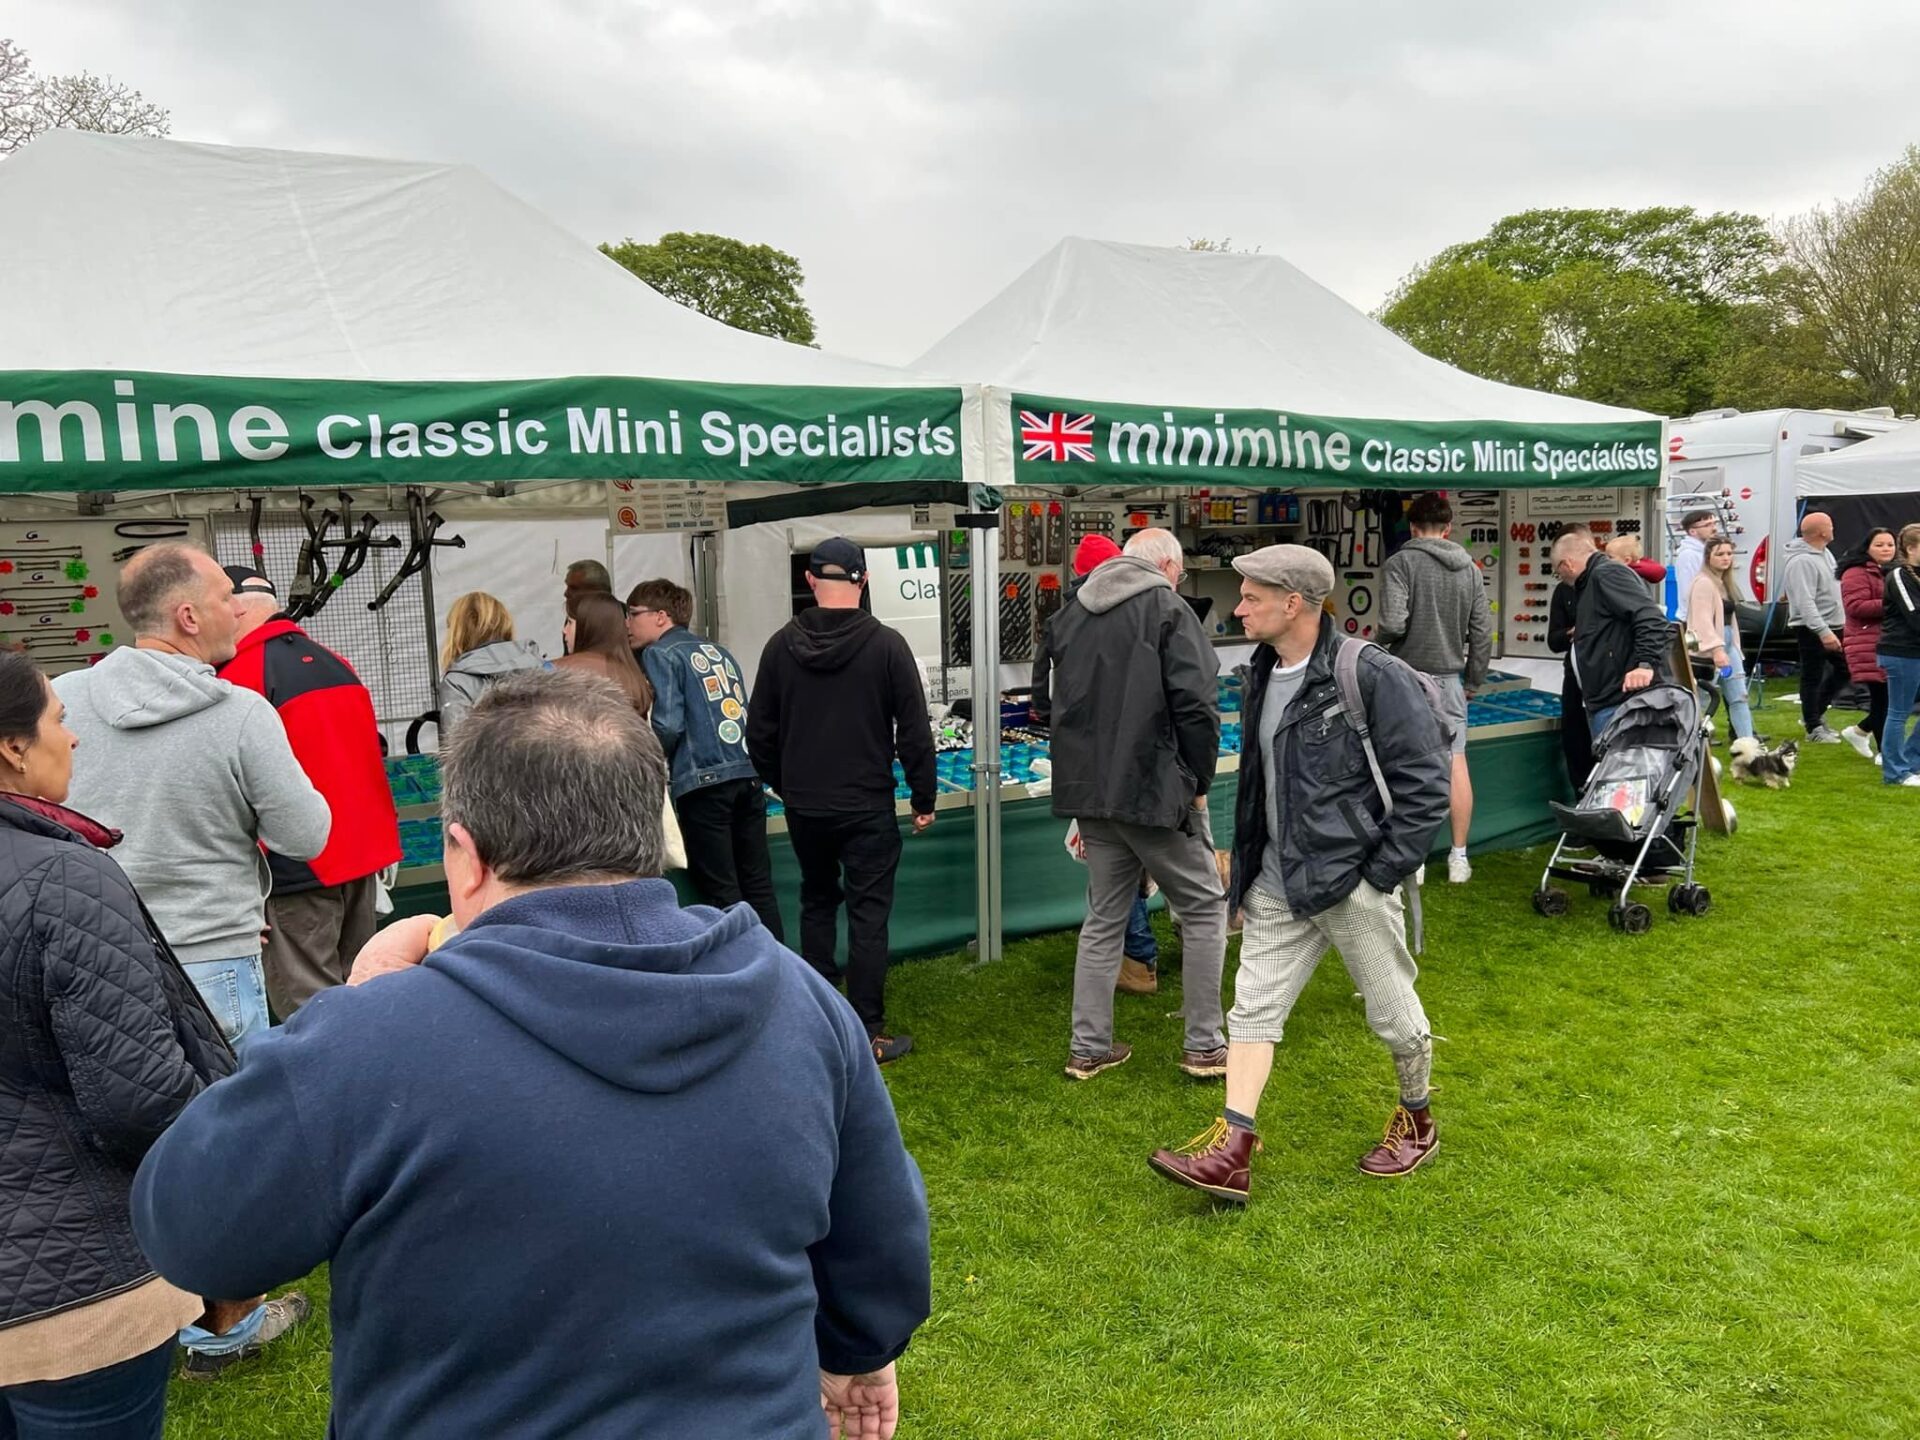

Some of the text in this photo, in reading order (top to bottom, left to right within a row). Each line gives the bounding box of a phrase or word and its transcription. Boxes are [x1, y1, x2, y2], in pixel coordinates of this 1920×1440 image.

[317, 409, 549, 459] Classic
[567, 408, 683, 454] Mini
[701, 410, 956, 467] Specialists
[1109, 412, 1656, 479] minimine Classic Mini Specialists
